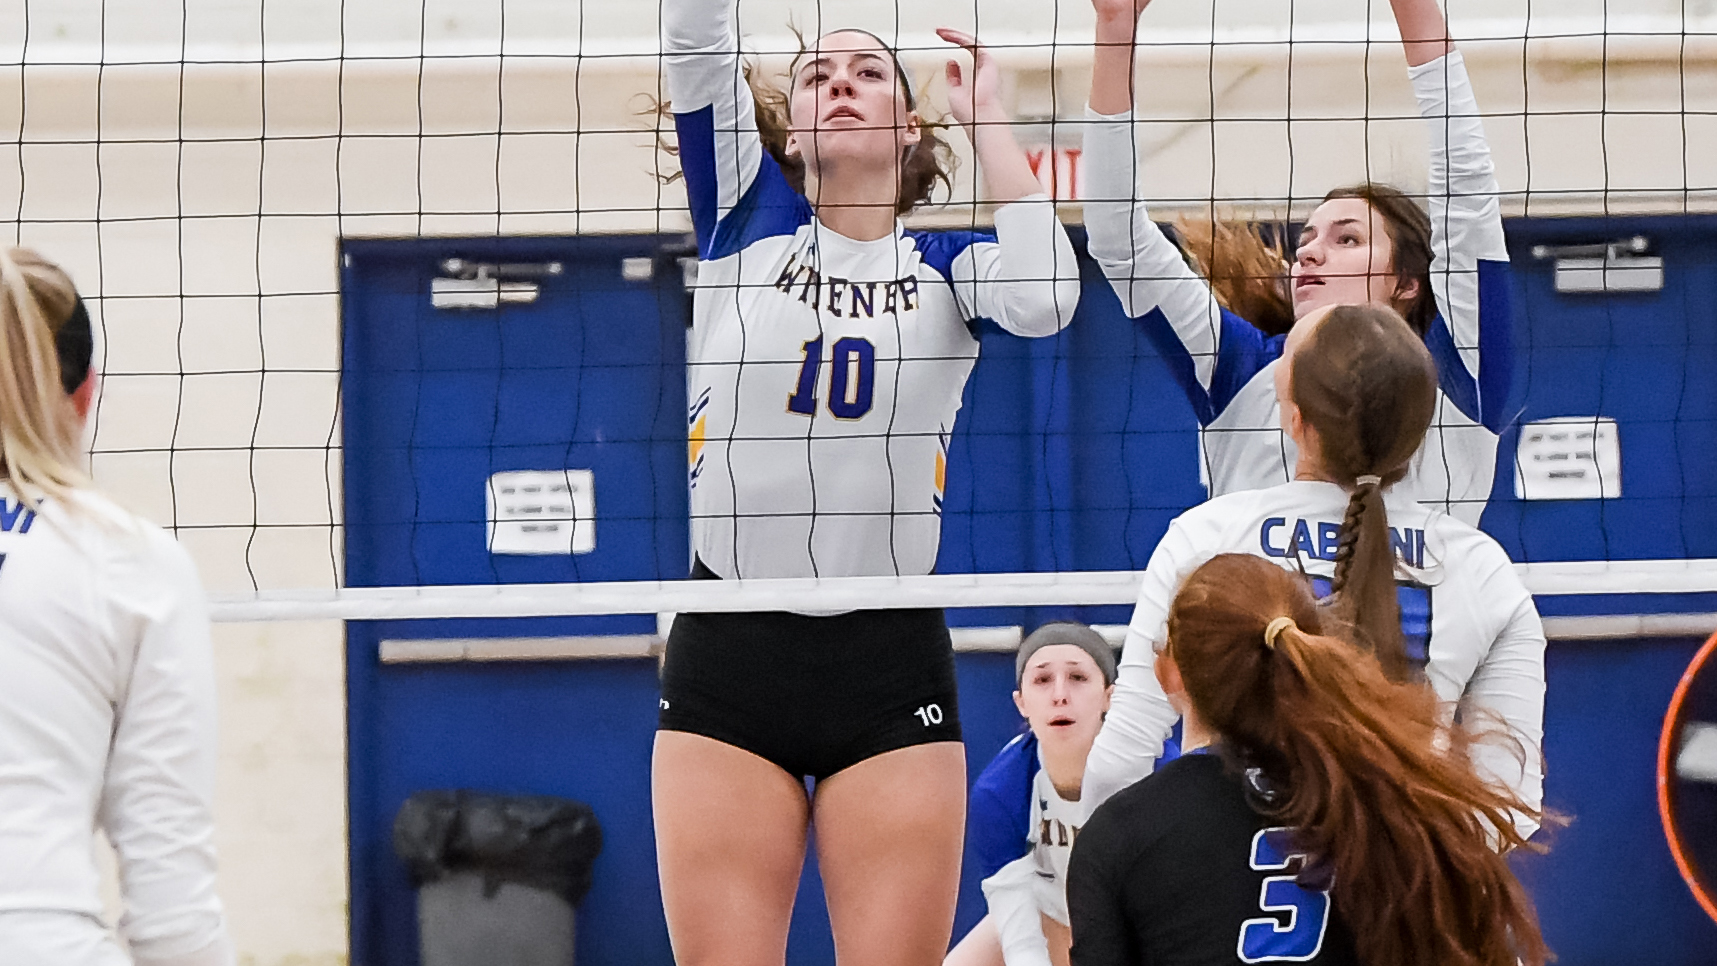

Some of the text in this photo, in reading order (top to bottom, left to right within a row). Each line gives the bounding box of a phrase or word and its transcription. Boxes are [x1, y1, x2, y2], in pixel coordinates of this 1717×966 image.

[1024, 148, 1083, 200] XIT
[774, 251, 920, 318] WIENER
[785, 333, 876, 421] 10
[1260, 517, 1426, 570] CABNI
[913, 703, 943, 727] 10
[1237, 826, 1331, 964] 3
